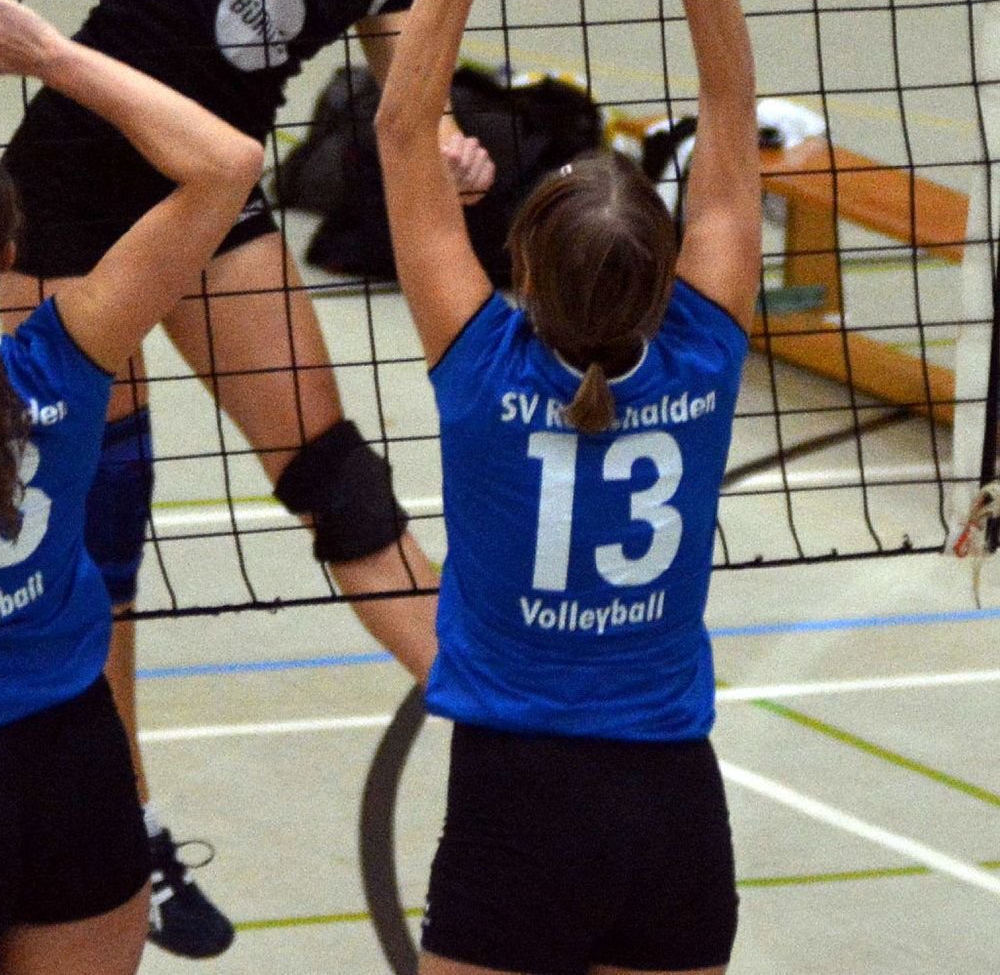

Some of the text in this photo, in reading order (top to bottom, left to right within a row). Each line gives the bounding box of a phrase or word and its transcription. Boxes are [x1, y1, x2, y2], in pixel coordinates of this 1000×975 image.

[500, 389, 717, 430] SV Rhalden
[526, 430, 684, 592] 13
[519, 590, 666, 636] Volleyball
